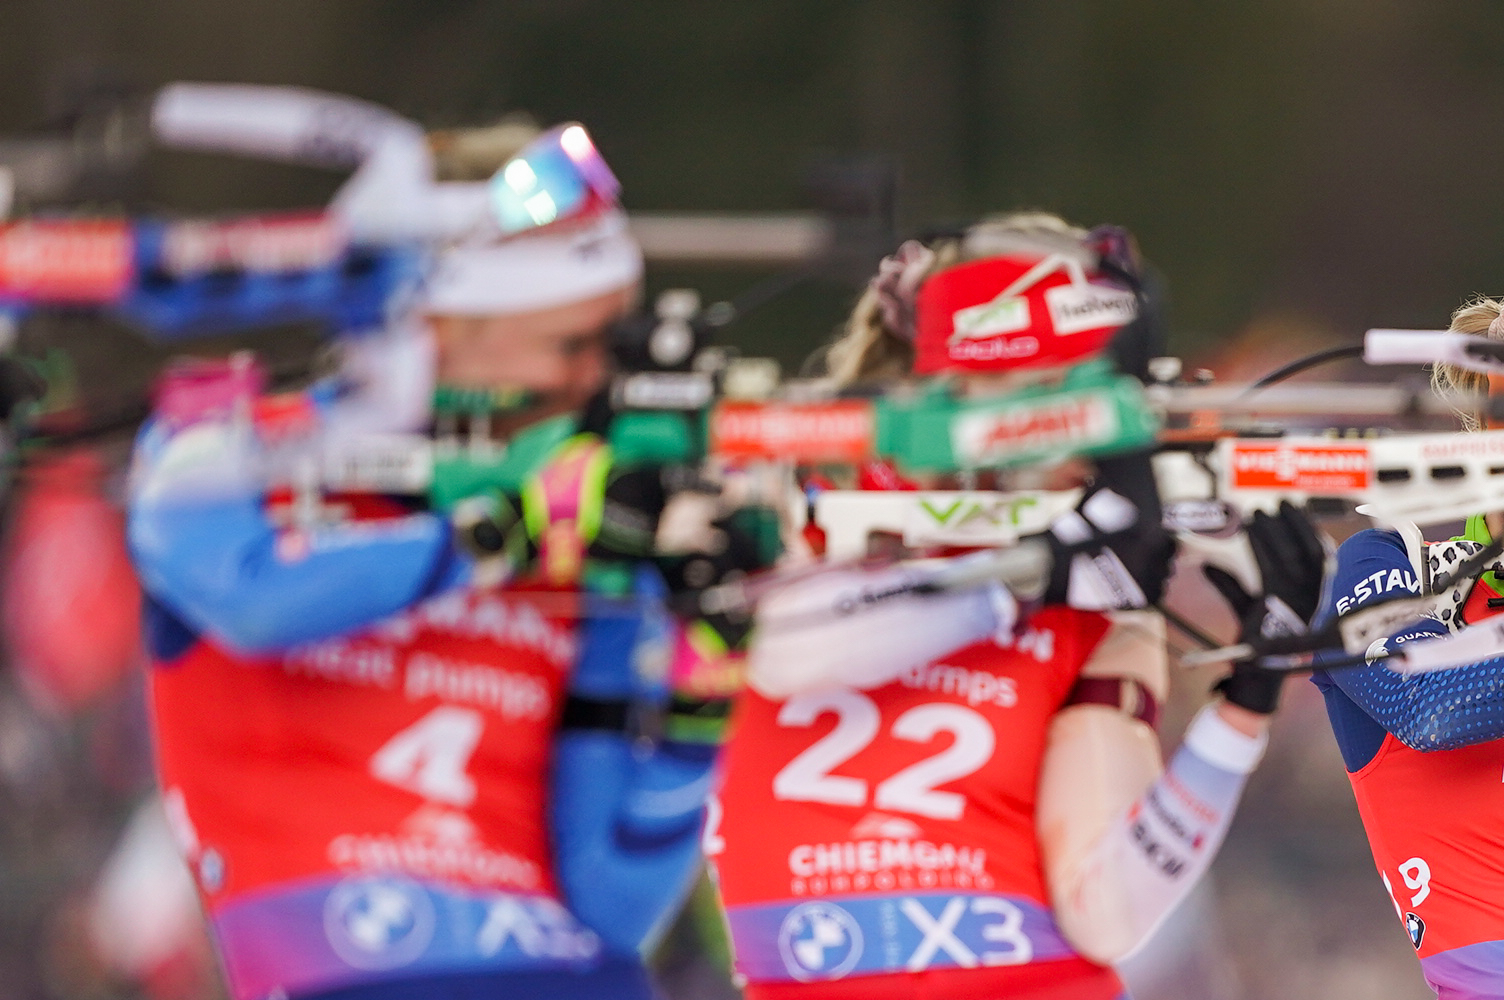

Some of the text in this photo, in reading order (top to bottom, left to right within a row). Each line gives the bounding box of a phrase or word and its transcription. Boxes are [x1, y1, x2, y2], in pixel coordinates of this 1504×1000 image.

[902, 663, 1019, 708] umps
[369, 704, 484, 807] 4
[773, 690, 996, 821] 22
[901, 895, 1033, 973] X3
